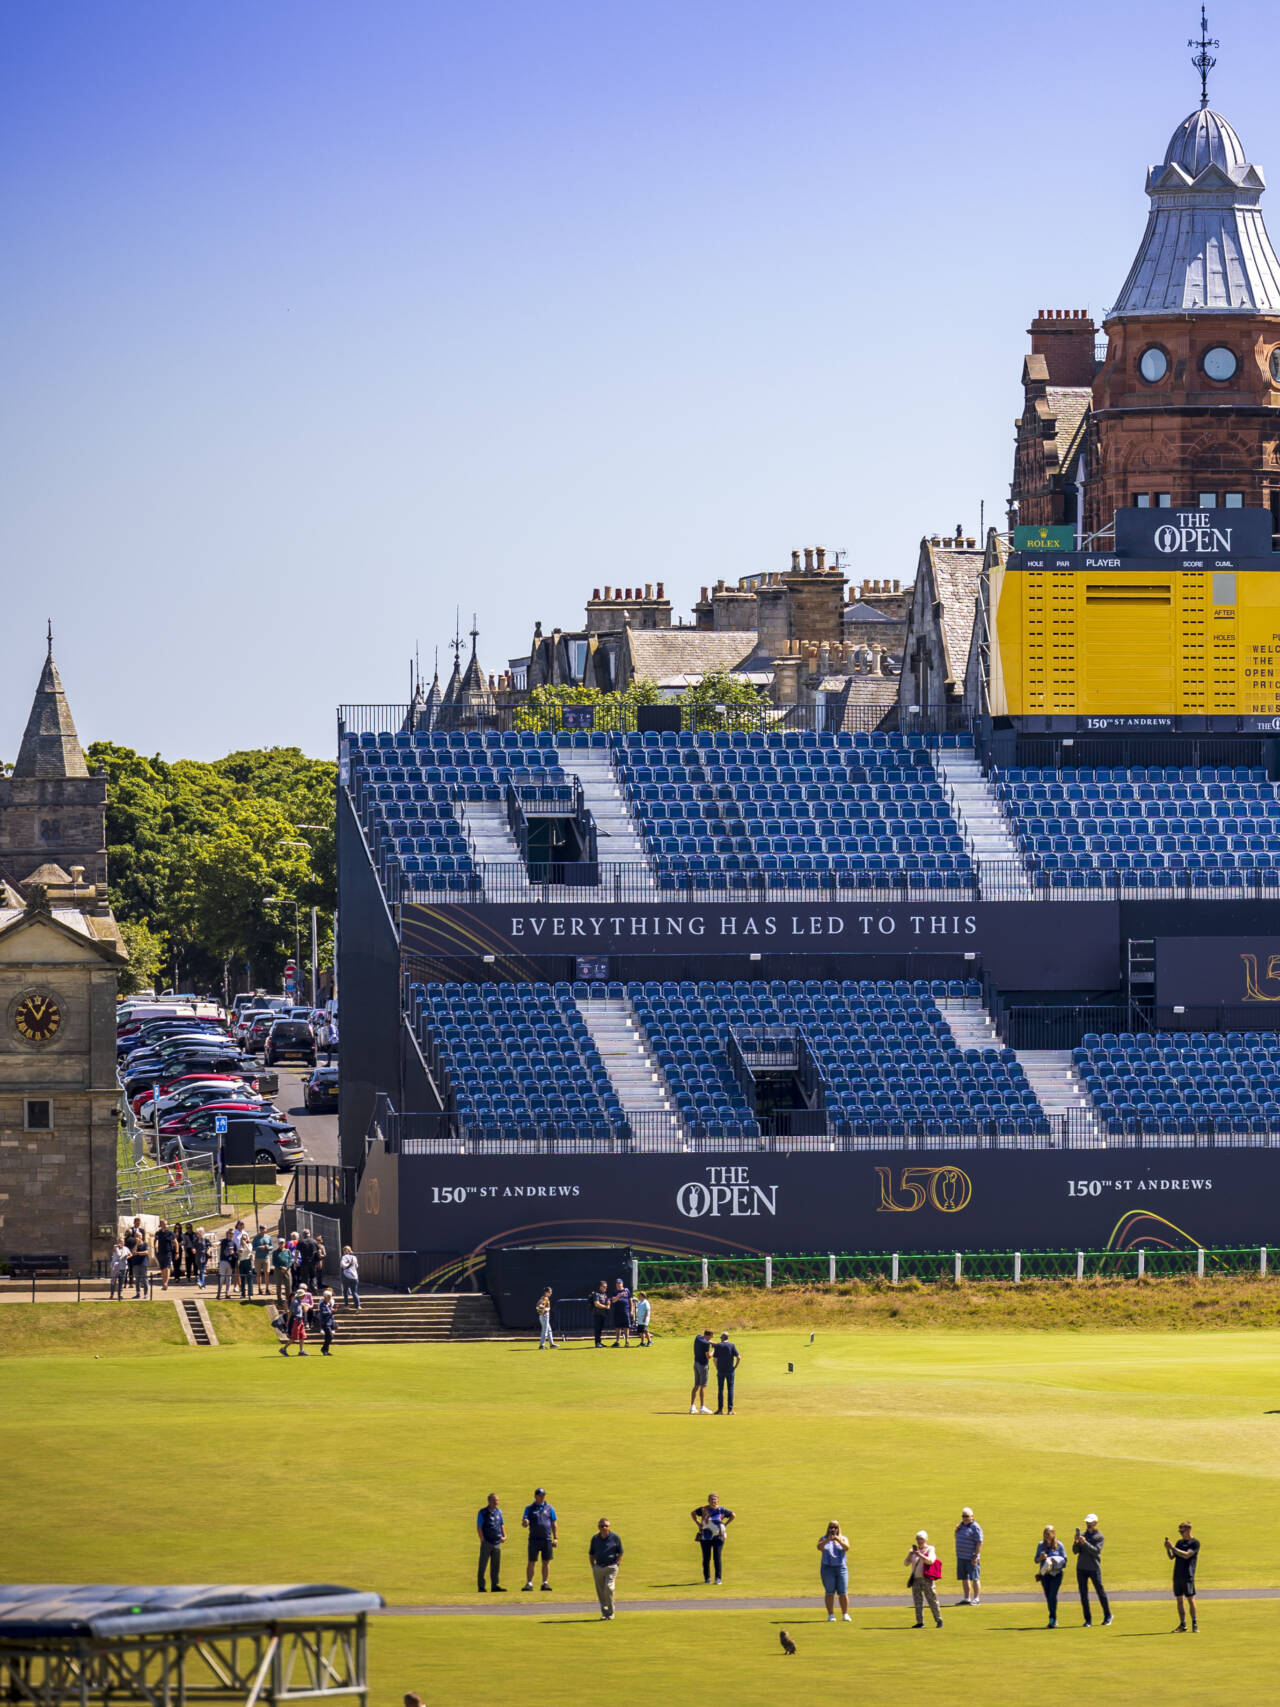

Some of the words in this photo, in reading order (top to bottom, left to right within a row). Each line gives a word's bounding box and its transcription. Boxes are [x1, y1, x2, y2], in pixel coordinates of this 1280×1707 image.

[1176, 513, 1211, 528] THE
[1027, 540, 1060, 548] ROLEX
[1154, 524, 1233, 553] OPEN
[1086, 558, 1121, 568] PLAYER
[1183, 560, 1204, 568] SCORE
[1253, 657, 1274, 666] THE
[1244, 669, 1274, 678] OPEN
[1127, 718, 1172, 726] ANDREWS
[511, 916, 706, 936] EVERYTHING
[720, 916, 777, 935] HAS
[791, 916, 844, 935] LED
[858, 915, 896, 934] TO
[910, 915, 977, 934] THIS
[705, 1166, 750, 1185] THE
[480, 1186, 499, 1197] ST
[503, 1185, 580, 1197] ANDREWS
[875, 1165, 973, 1213] 150
[1114, 1180, 1133, 1191] ST
[1137, 1179, 1213, 1190] ANDREWS
[676, 1182, 779, 1218] OPEN
